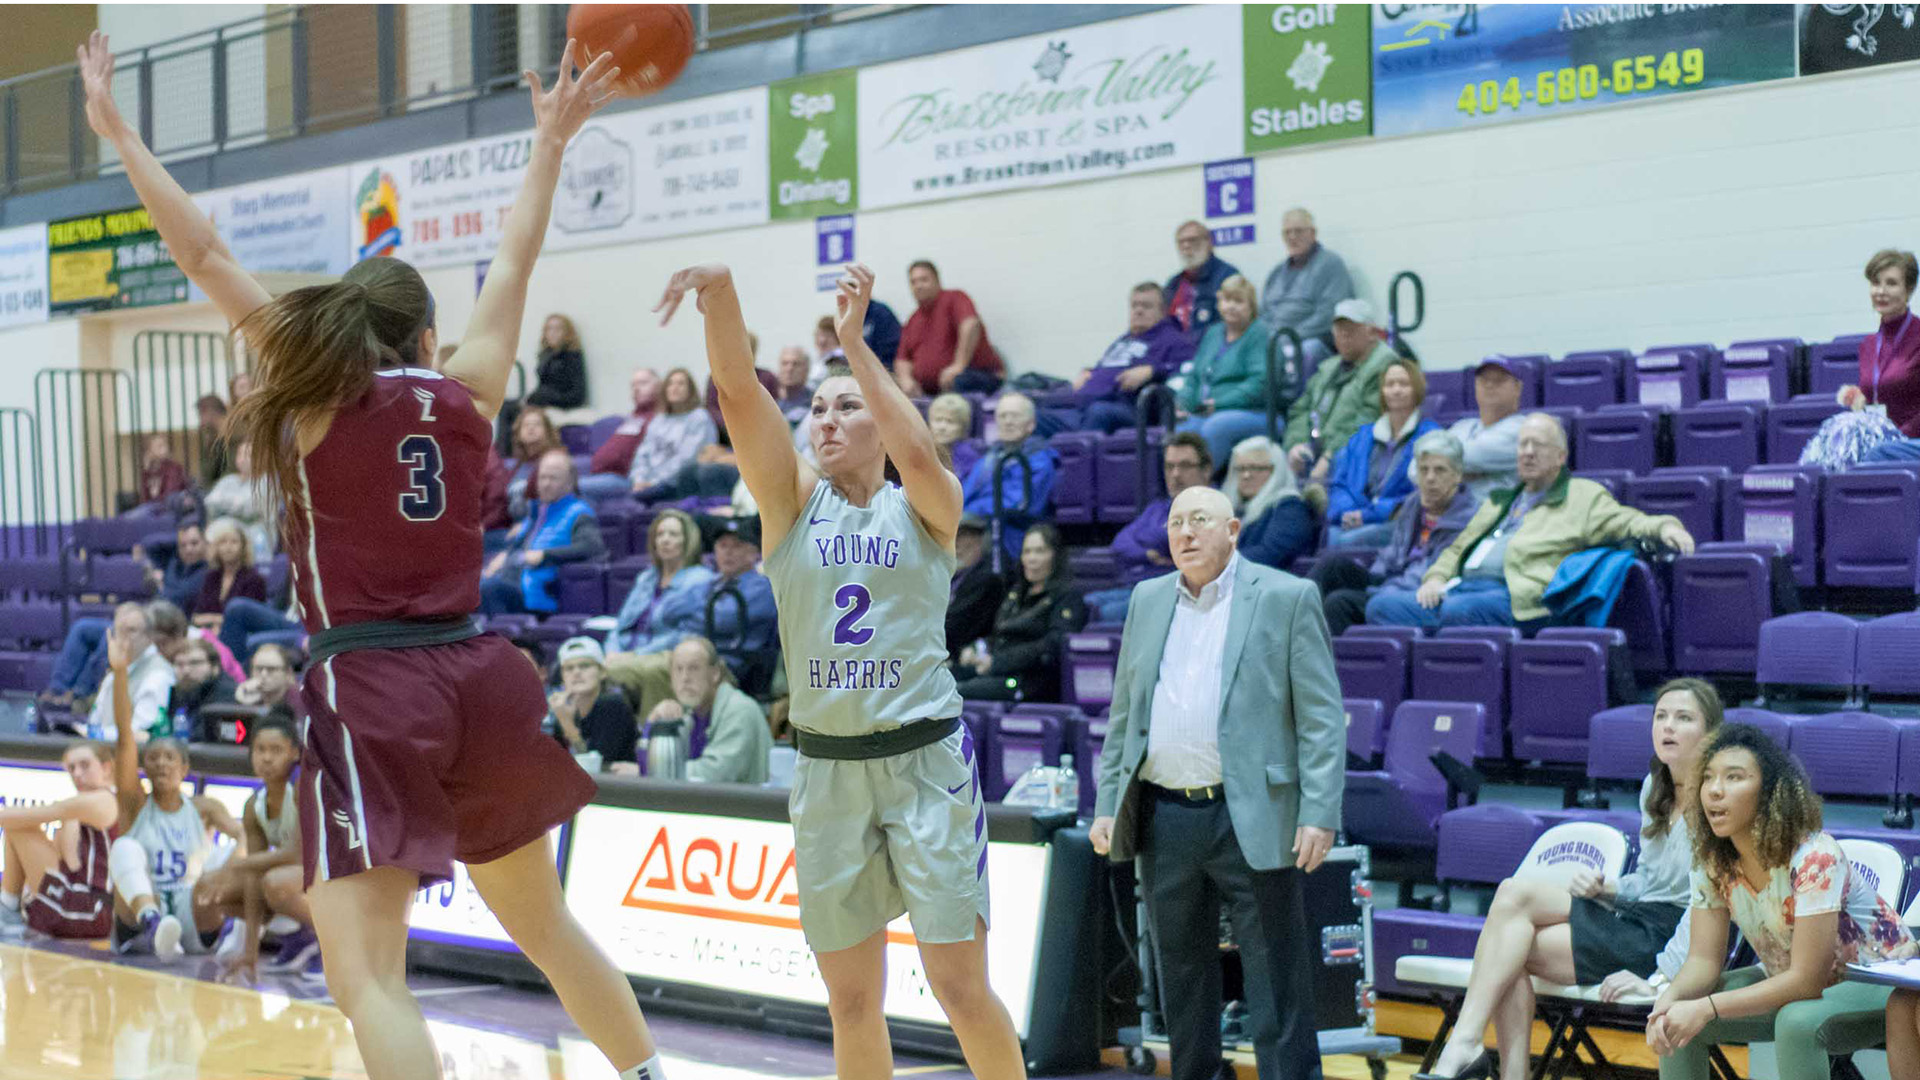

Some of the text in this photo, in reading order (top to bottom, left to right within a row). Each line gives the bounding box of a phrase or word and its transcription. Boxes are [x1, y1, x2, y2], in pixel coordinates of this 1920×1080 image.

[1272, 4, 1337, 33] Golf
[789, 92, 835, 121] Spa
[873, 44, 1222, 151] Brasstown Valley
[1251, 98, 1364, 136] Stables
[935, 128, 1050, 160] RESORT
[1094, 114, 1149, 137] SPA
[410, 150, 472, 186] PAPA'S
[913, 141, 1175, 190] www.BrasstownValley.com
[779, 177, 851, 205] Dining
[1220, 182, 1238, 213] C
[397, 434, 446, 522] 3
[815, 533, 900, 570] YOUNG
[832, 582, 875, 647] 2
[808, 659, 904, 690] HARRIS
[155, 850, 188, 879] 15
[1536, 841, 1606, 871] YOUNG HARRIS
[1850, 860, 1881, 891] ARRIS
